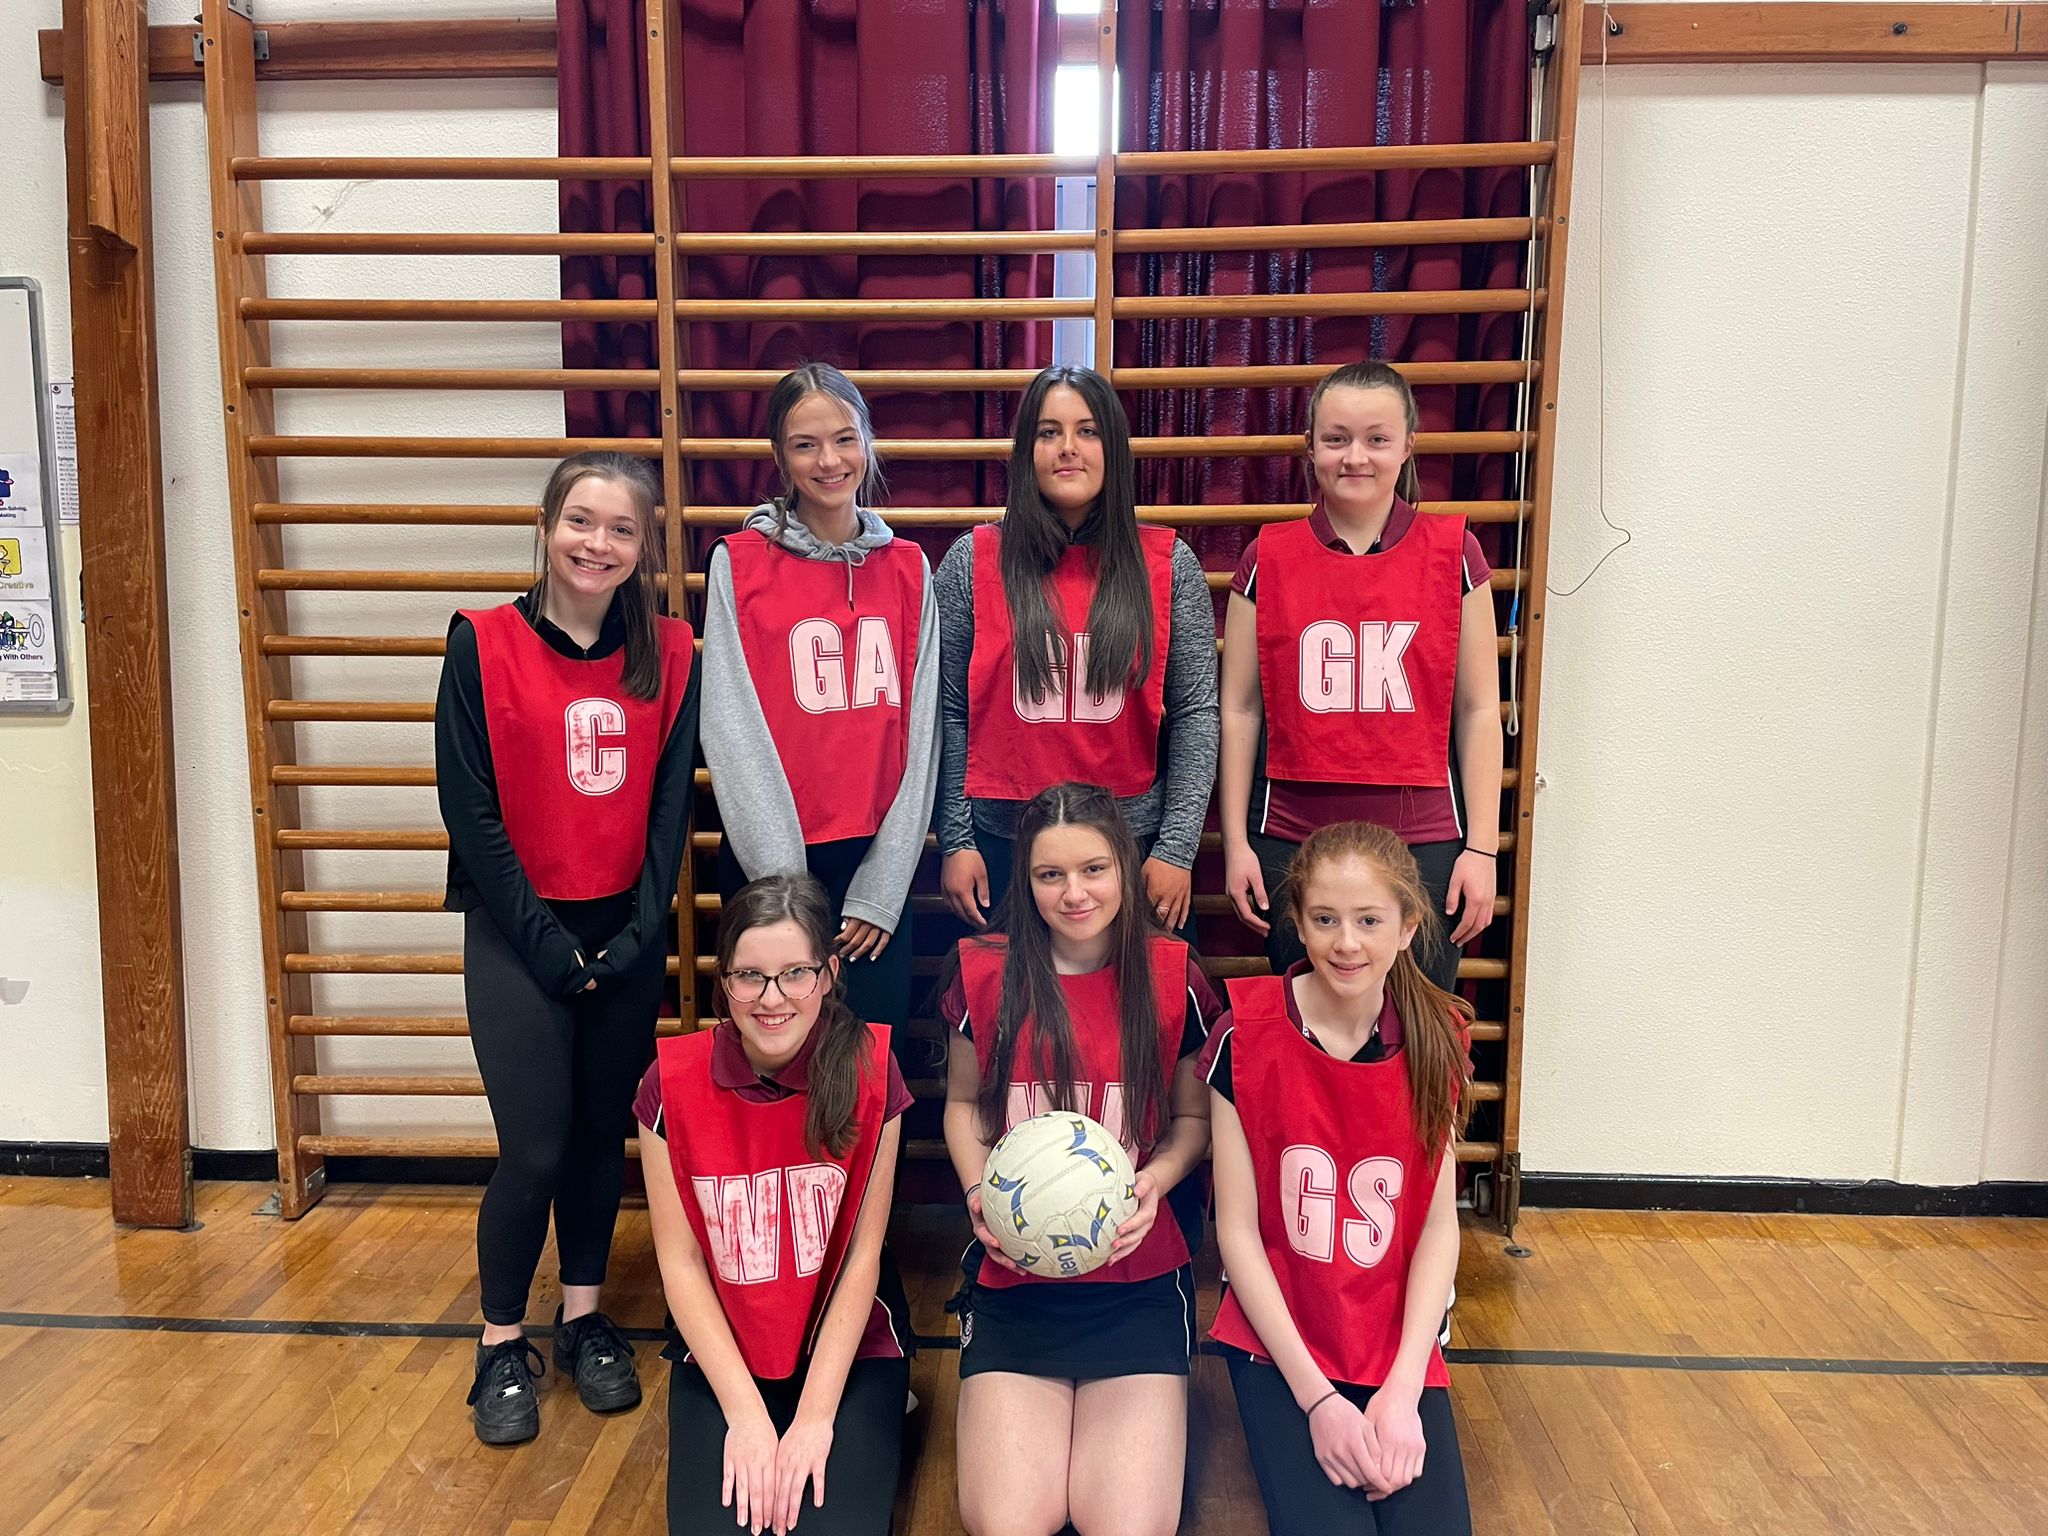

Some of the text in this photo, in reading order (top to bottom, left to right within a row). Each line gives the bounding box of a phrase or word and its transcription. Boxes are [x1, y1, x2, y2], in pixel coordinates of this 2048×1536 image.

[789, 617, 901, 714] GA
[1299, 620, 1420, 713] GK
[564, 697, 626, 796] C
[691, 1162, 848, 1285] WD
[1280, 1144, 1404, 1268] GS
